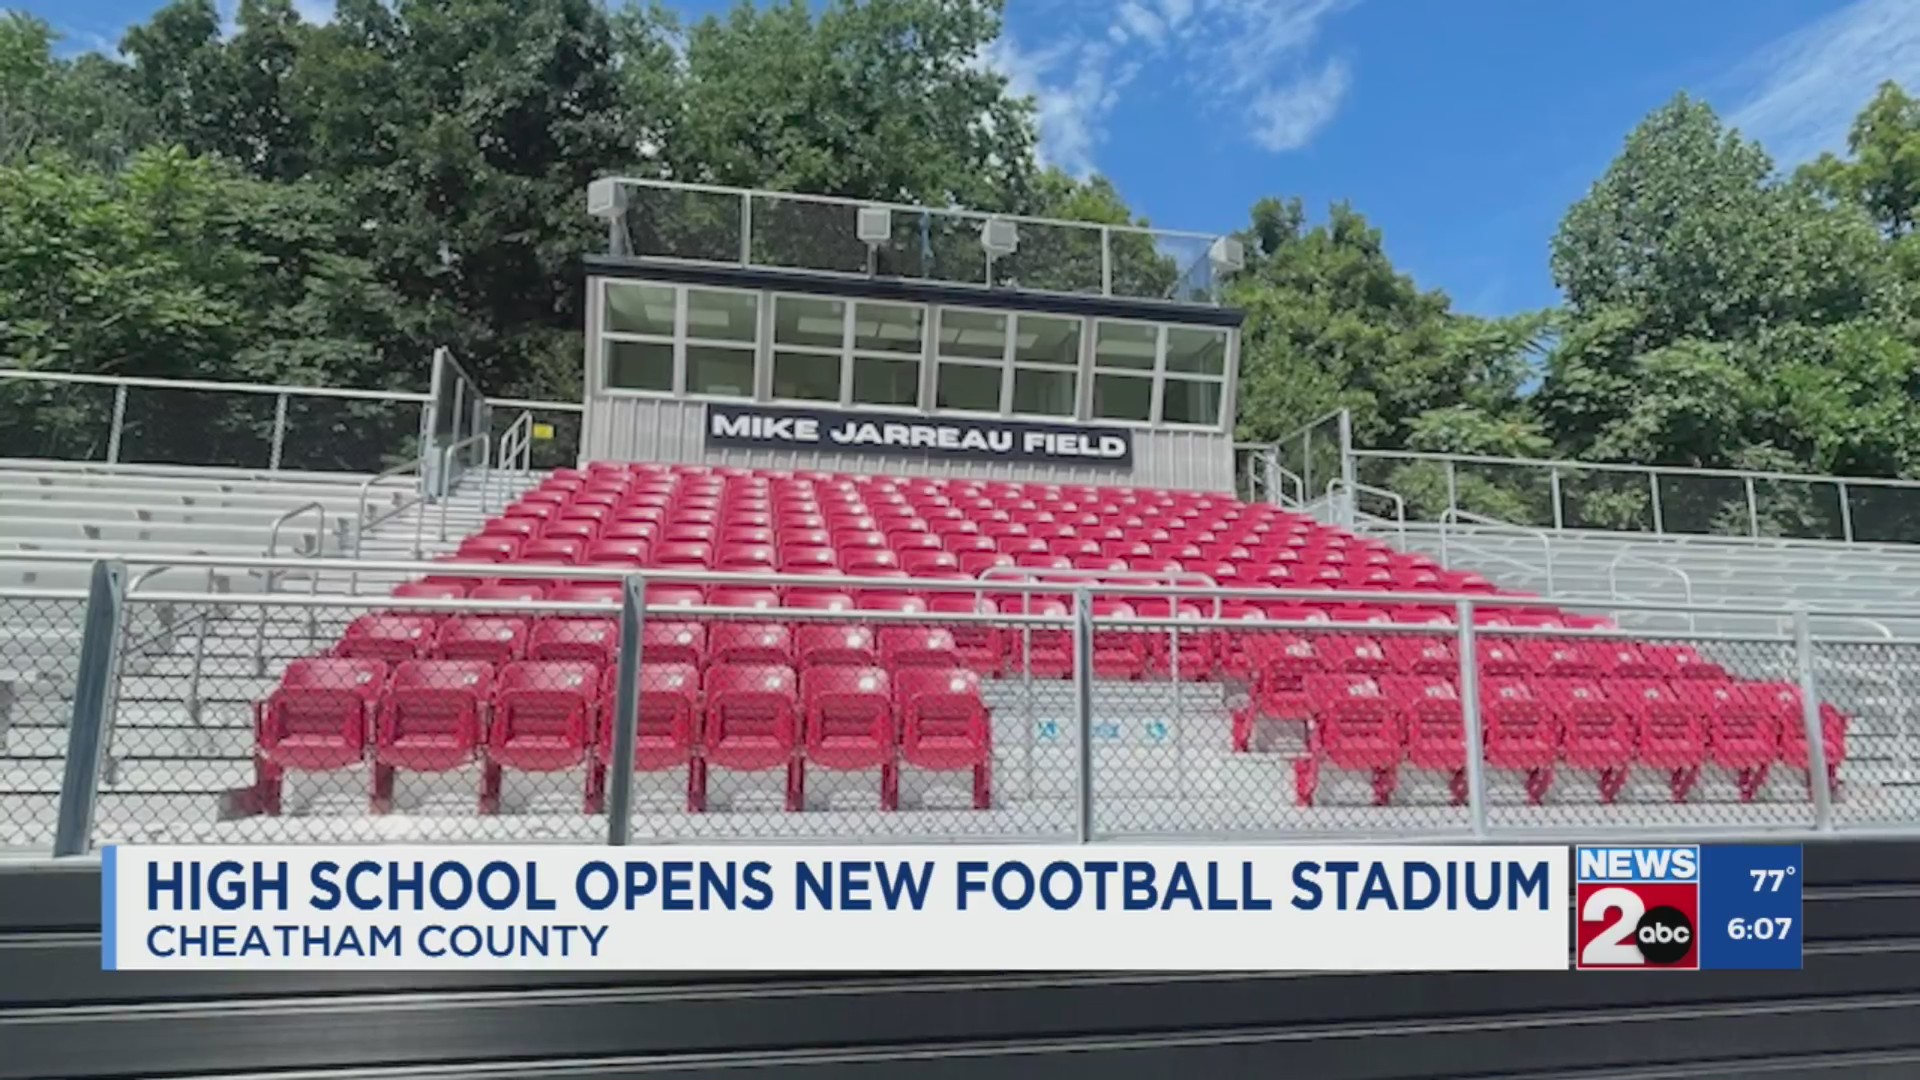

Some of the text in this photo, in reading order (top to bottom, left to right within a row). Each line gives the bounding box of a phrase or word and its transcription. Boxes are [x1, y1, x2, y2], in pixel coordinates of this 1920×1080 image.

[712, 414, 1126, 458] MIKE JARREAU FIELD
